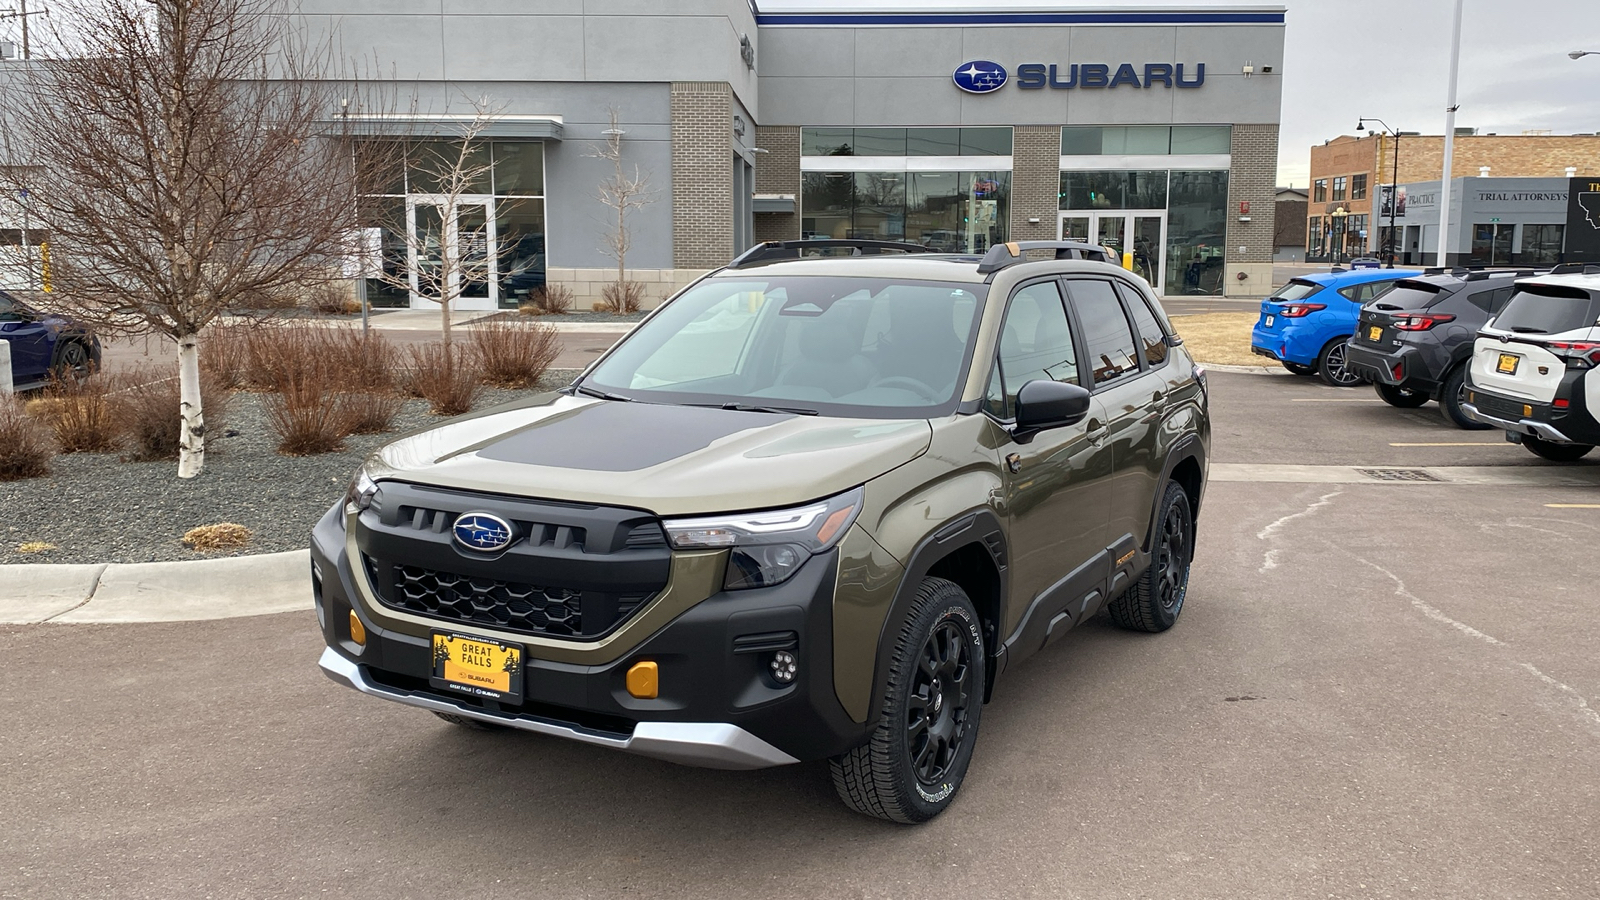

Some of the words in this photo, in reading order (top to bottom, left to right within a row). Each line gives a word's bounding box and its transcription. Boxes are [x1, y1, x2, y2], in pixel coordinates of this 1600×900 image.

[1017, 63, 1205, 89] SUBARU
[1408, 193, 1435, 205] PRACTICE
[1479, 192, 1509, 201] TRIAL
[1511, 192, 1568, 201] ATTORNEYS
[462, 643, 492, 657] GREAT
[462, 653, 492, 668] FALLS
[467, 674, 495, 684] SUBARU
[481, 690, 501, 698] SUBARU
